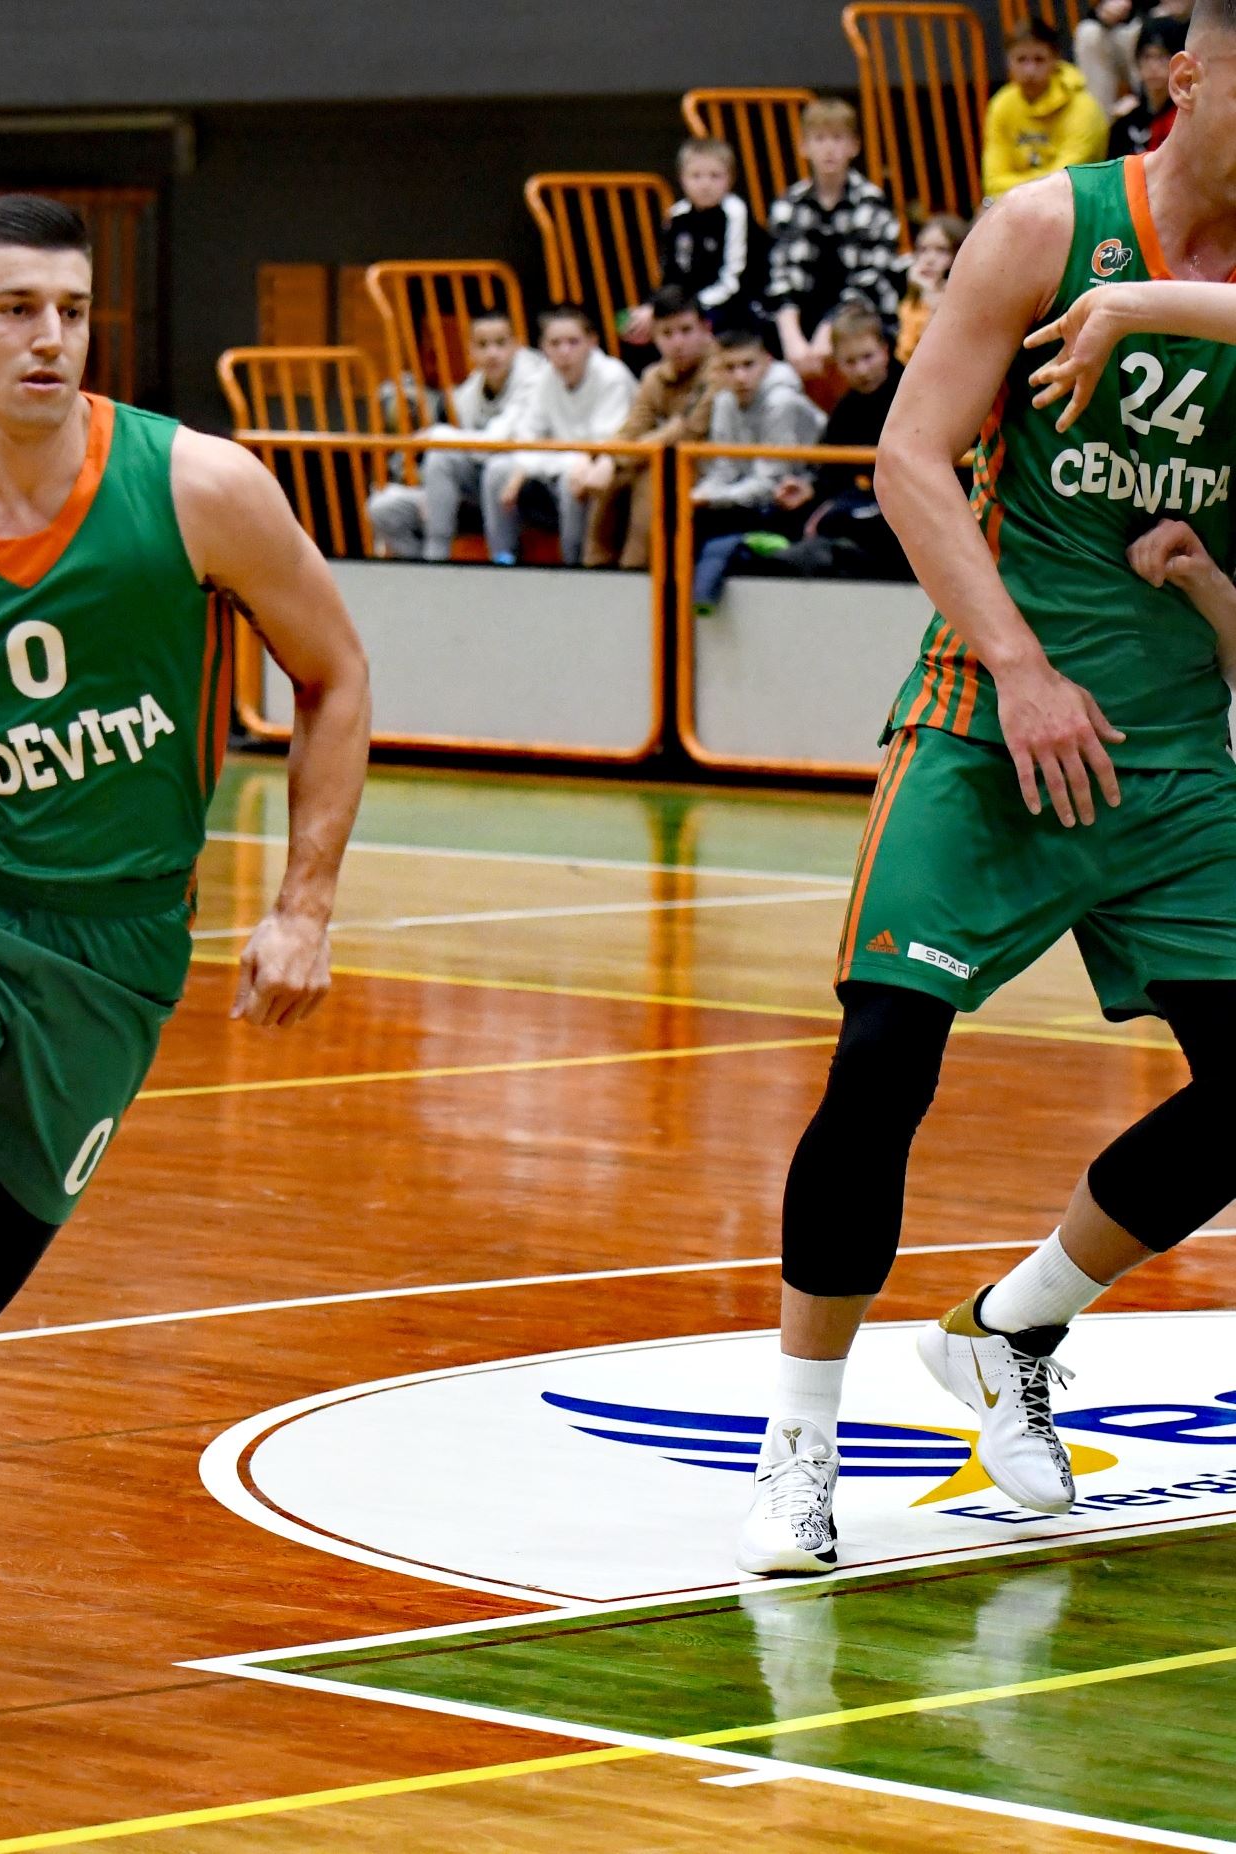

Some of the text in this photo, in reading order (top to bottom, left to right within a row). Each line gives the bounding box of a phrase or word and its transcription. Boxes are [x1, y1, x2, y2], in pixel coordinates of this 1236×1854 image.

[1120, 352, 1207, 445] 24
[6, 620, 67, 699] 0
[925, 950, 968, 977] SPAR
[65, 1118, 113, 1195] 0
